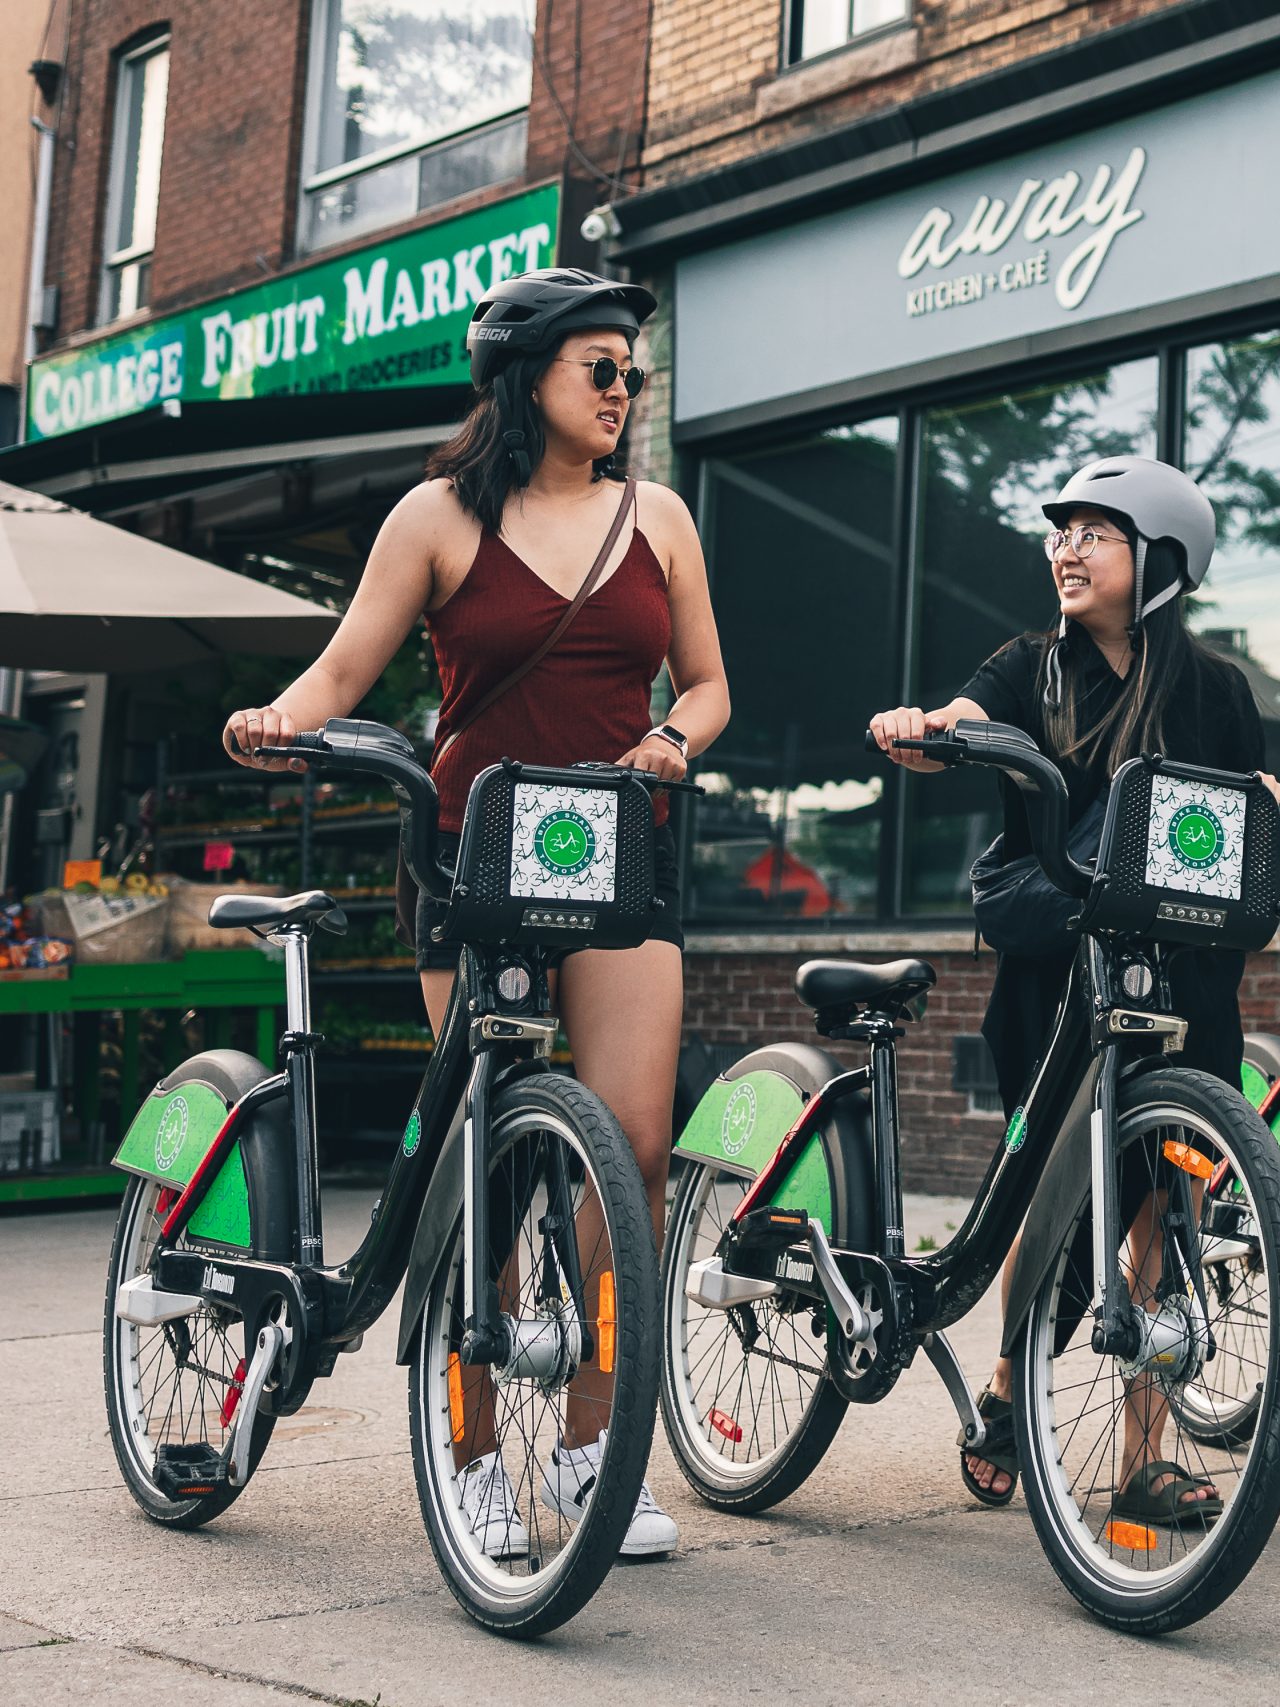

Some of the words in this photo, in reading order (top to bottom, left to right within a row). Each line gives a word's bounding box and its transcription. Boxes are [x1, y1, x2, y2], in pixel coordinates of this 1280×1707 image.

[898, 147, 1147, 312] away
[906, 272, 984, 318] KITCHEN
[1000, 248, 1050, 293] CAFÉ
[34, 341, 184, 436] COLLEGE
[201, 296, 326, 388] FRUIT
[342, 223, 550, 345] MARKET
[537, 814, 559, 836] BIKE
[564, 812, 594, 839] SHARE
[1171, 807, 1191, 828] BIKE
[1196, 807, 1223, 835] SHARE
[539, 854, 590, 874] TORONTO
[1172, 845, 1219, 867] TORONTO
[785, 1256, 814, 1283] TORONTO
